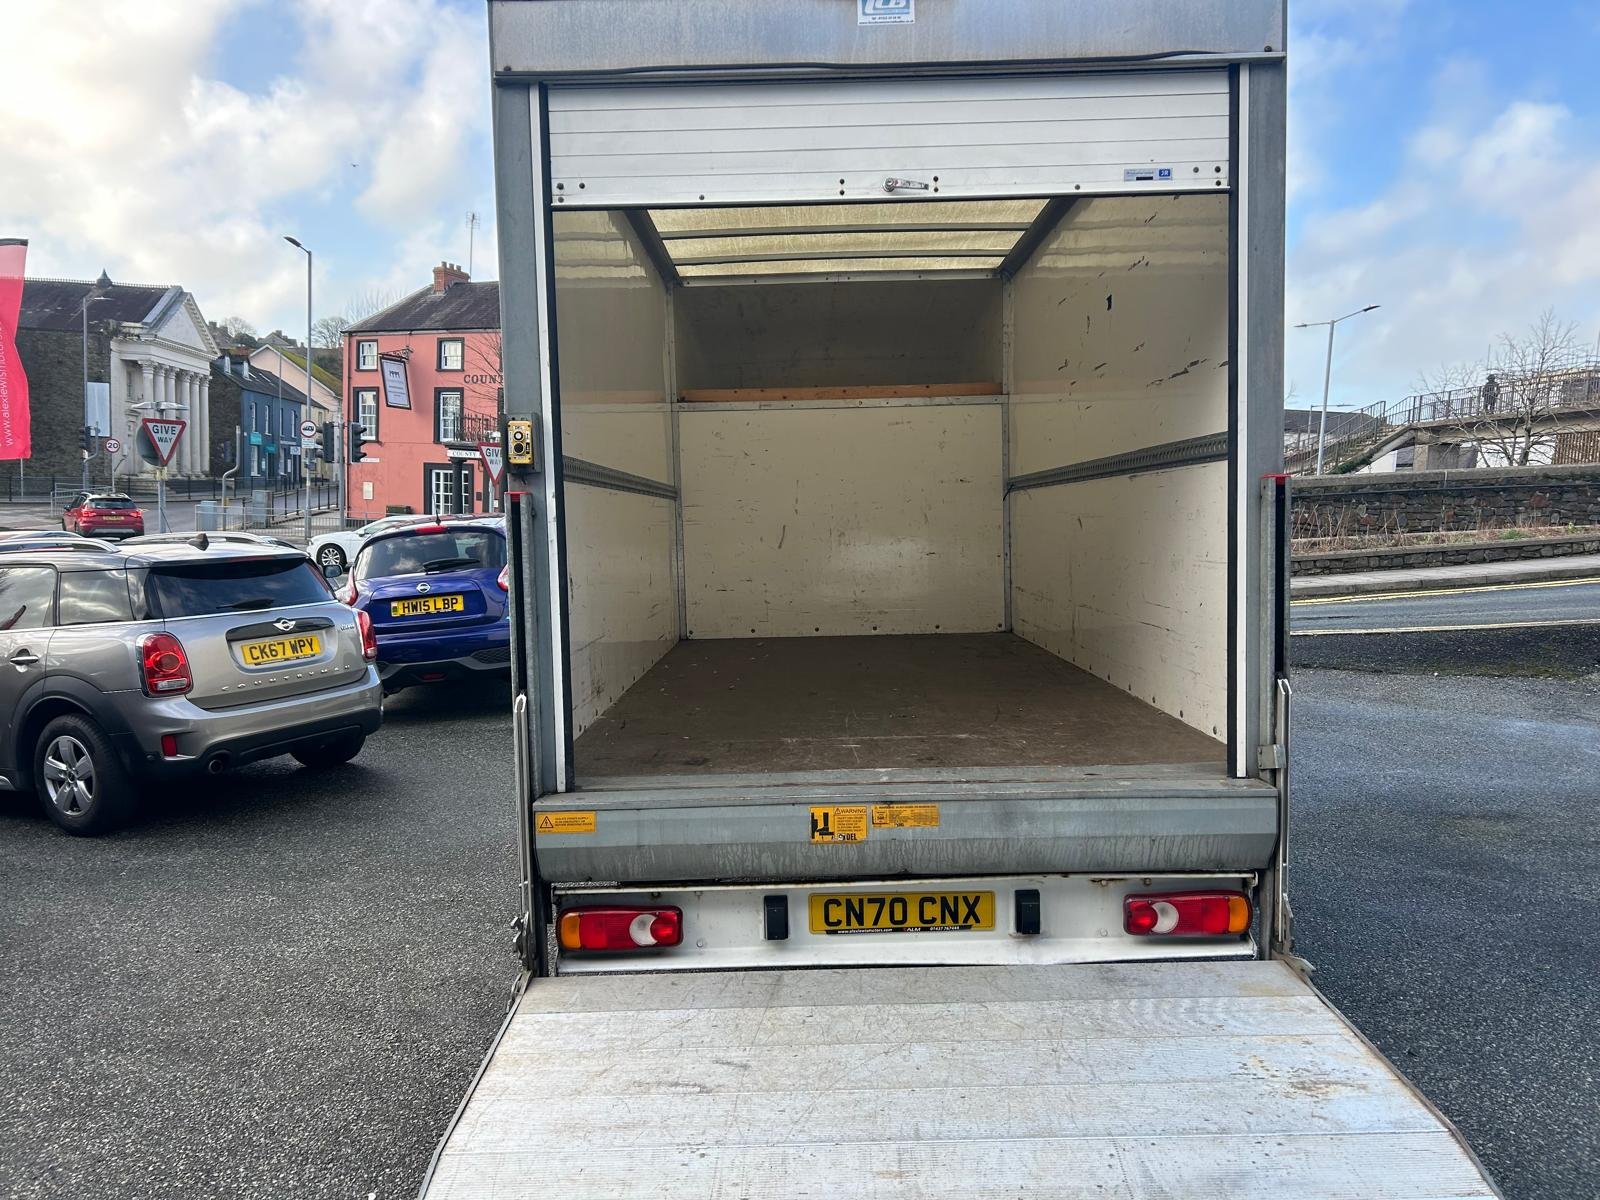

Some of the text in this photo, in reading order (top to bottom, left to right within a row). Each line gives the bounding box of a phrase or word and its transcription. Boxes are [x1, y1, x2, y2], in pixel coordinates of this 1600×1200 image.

[152, 424, 177, 435] GIVE
[402, 597, 458, 613] HW15 LBP
[249, 642, 287, 661] CK67
[290, 638, 315, 655] WPY
[823, 895, 981, 927] CN70 CNX
